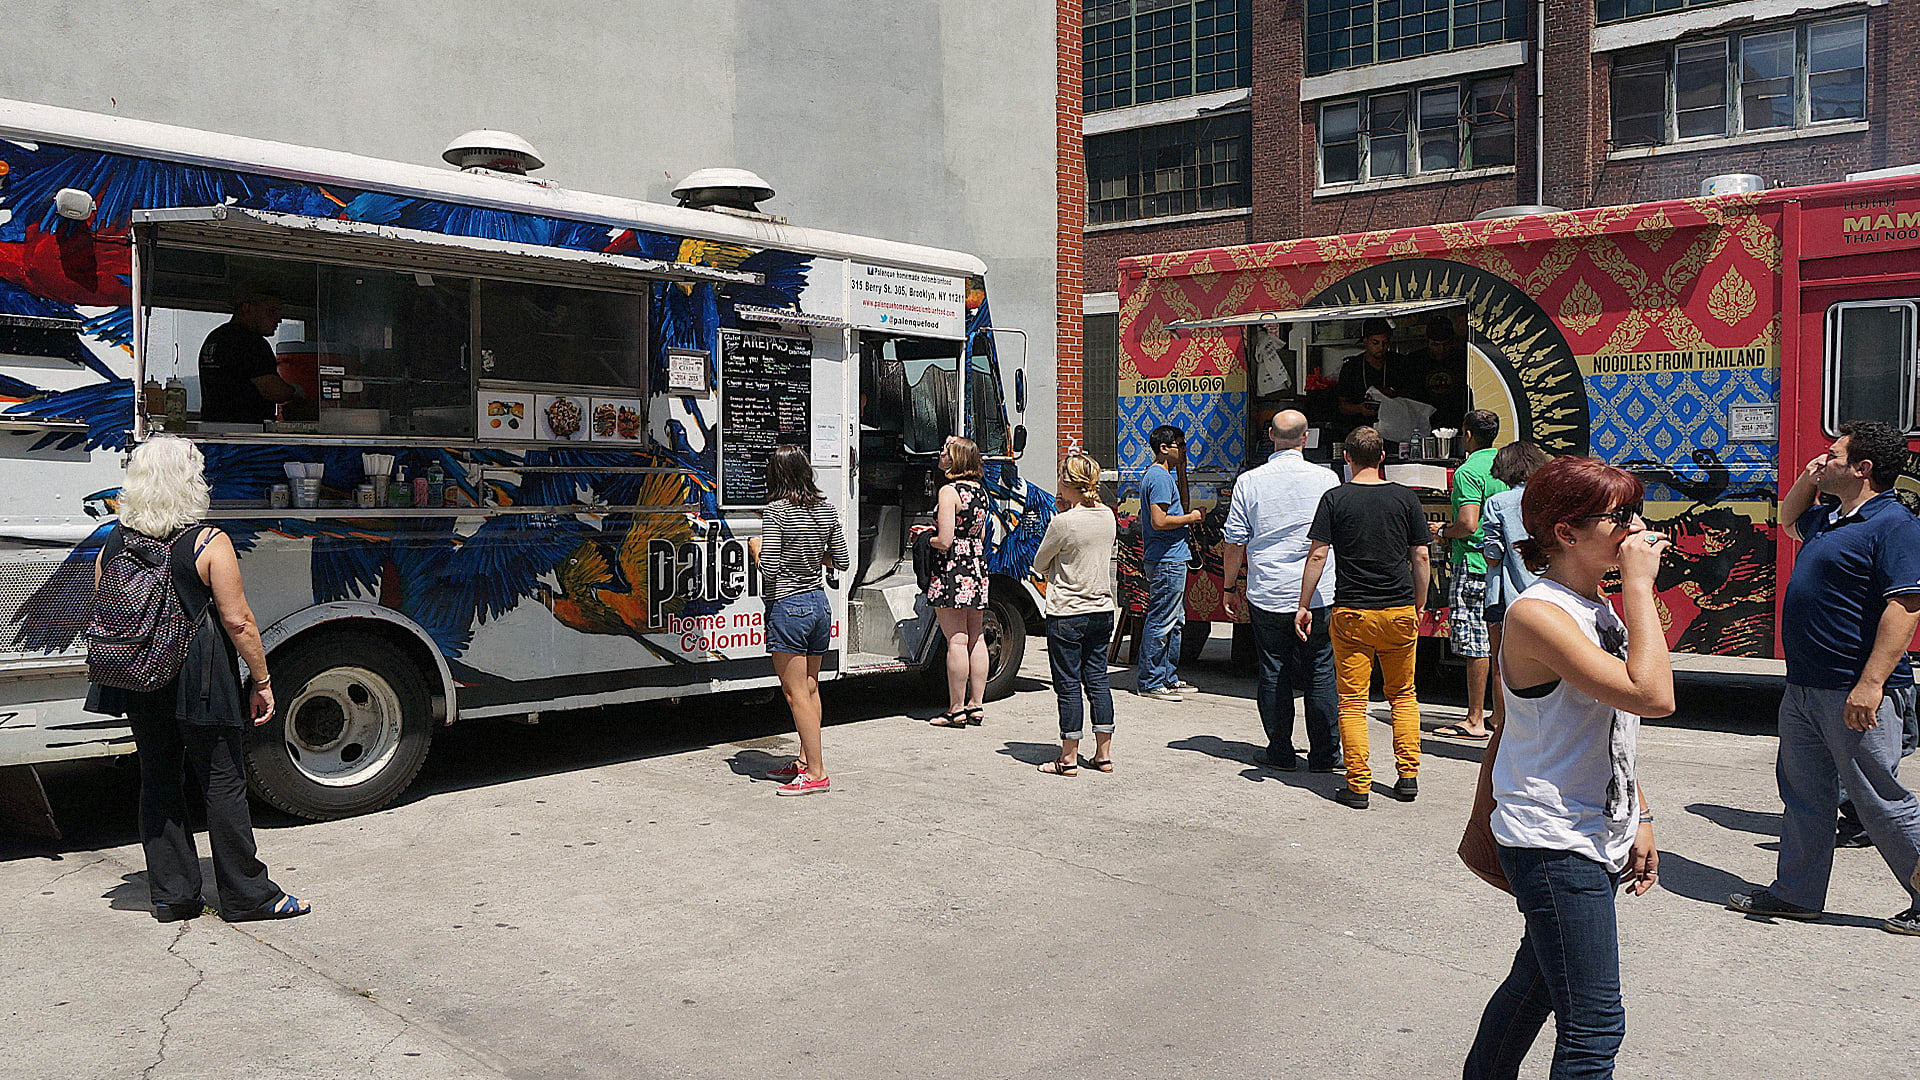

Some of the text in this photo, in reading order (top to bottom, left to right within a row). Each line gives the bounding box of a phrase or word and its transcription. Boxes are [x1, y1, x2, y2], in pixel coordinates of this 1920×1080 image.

[1843, 232, 1880, 245] THAI
[874, 268, 895, 278] Palenque
[897, 271, 920, 281] homemade
[851, 279, 863, 291] 315
[865, 282, 882, 295] Berry
[883, 283, 893, 294] St.
[894, 285, 908, 298] 305,
[909, 286, 937, 302] Brooklyn,
[938, 290, 947, 300] NY
[889, 316, 939, 328] @palenquefood
[742, 335, 789, 352] AREPAS
[1593, 348, 1766, 374] NOODLES FROM THAILAND
[648, 521, 839, 628] pale
[668, 612, 762, 634] home ma
